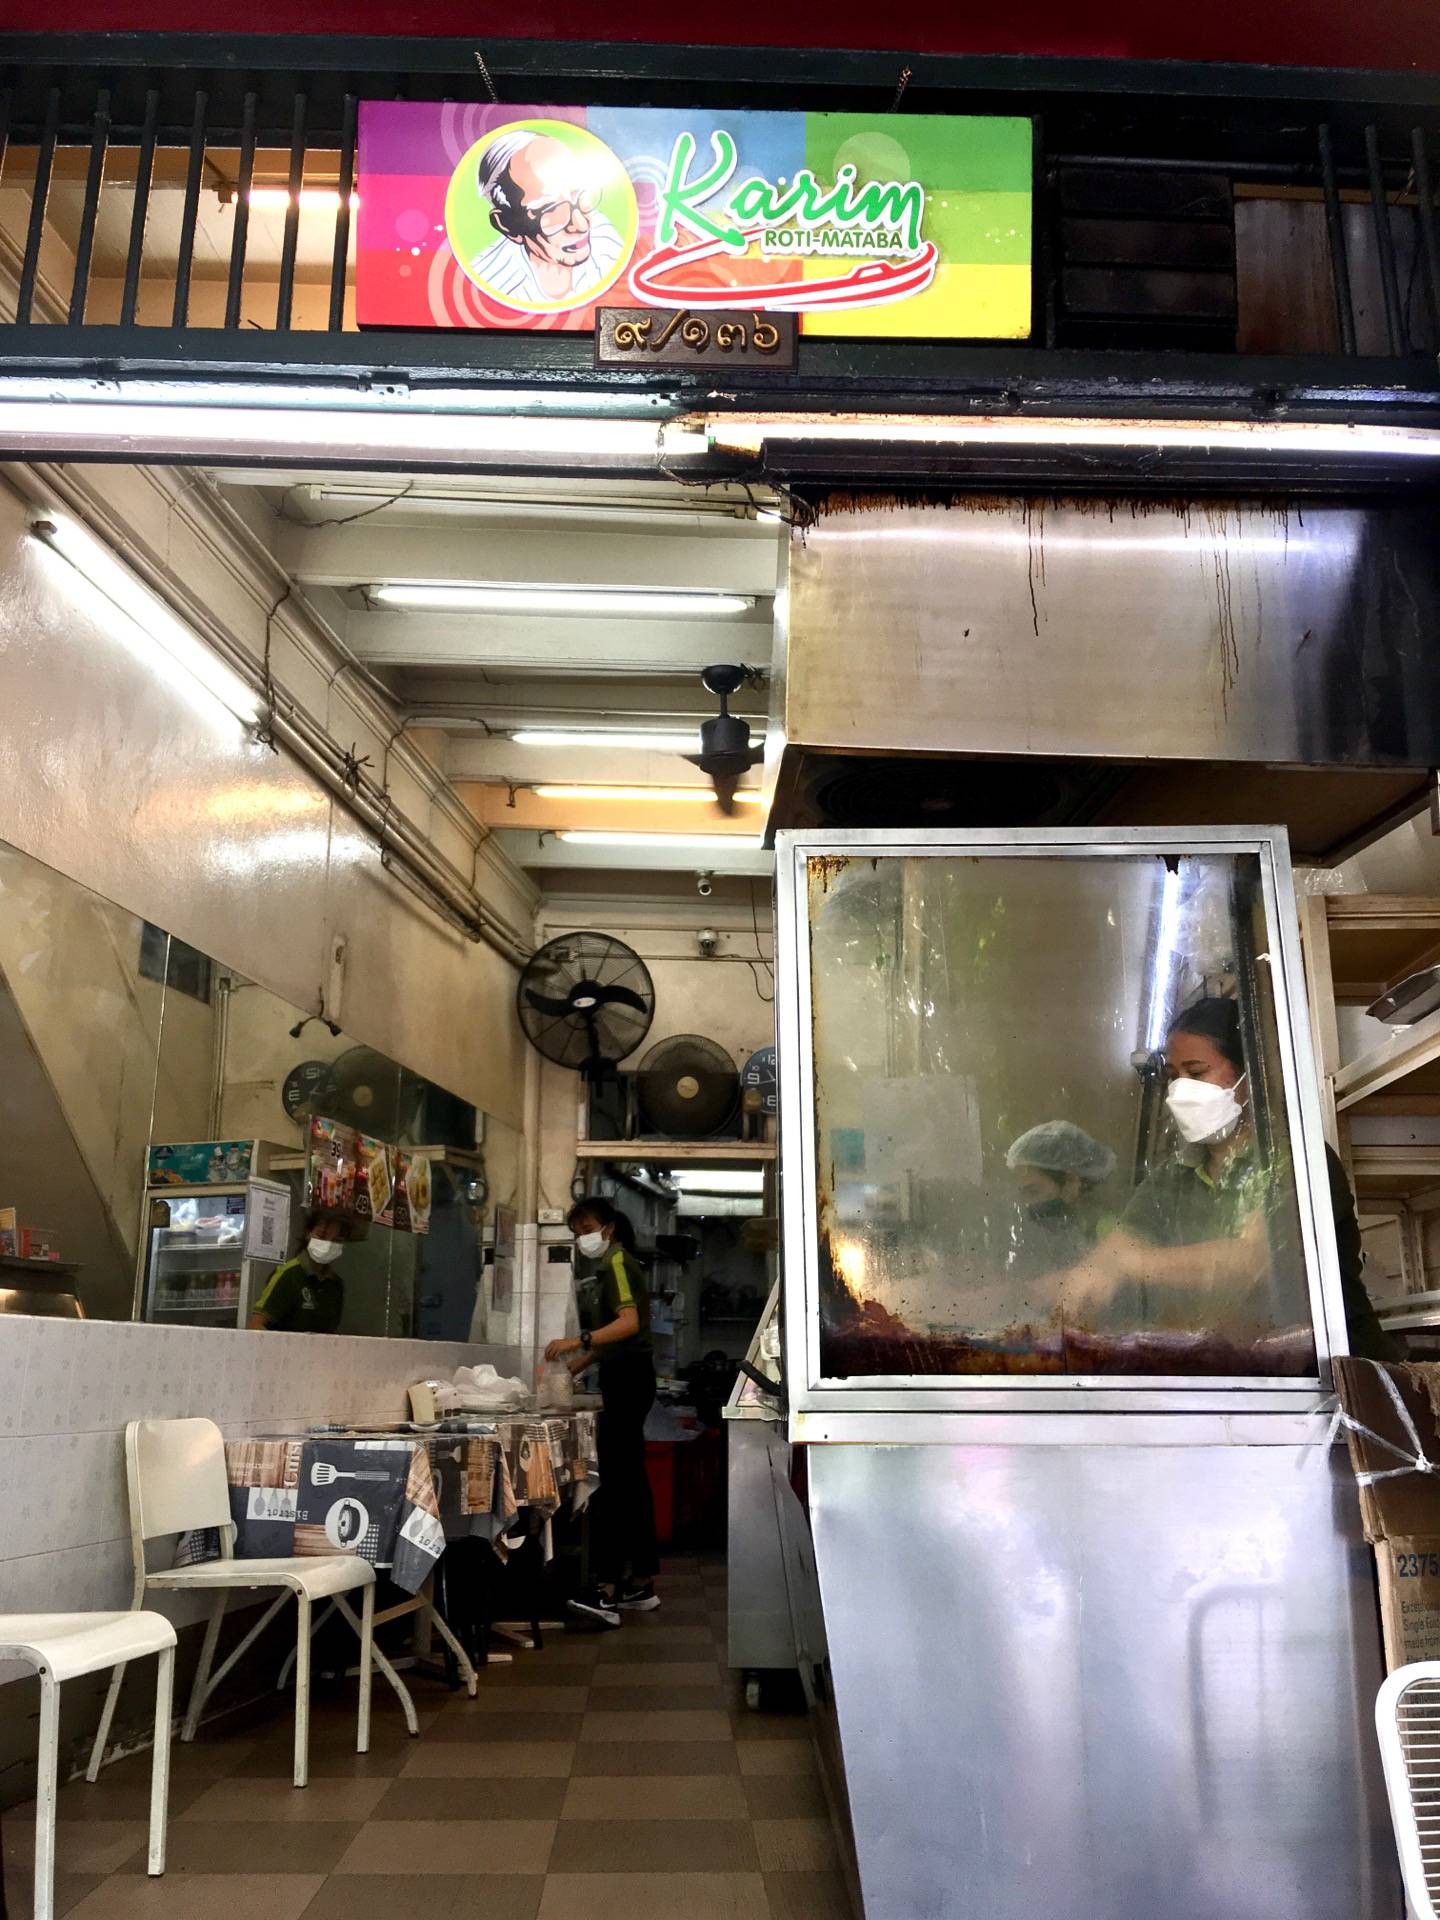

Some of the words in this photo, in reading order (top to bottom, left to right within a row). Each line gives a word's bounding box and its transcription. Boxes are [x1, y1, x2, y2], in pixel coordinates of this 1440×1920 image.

[659, 131, 921, 250] Karim
[764, 229, 903, 249] ROTI-MATABA
[613, 308, 779, 352] ๙/๑๓๖
[747, 1072, 760, 1085] 9
[266, 1508, 309, 1521] Bistrot
